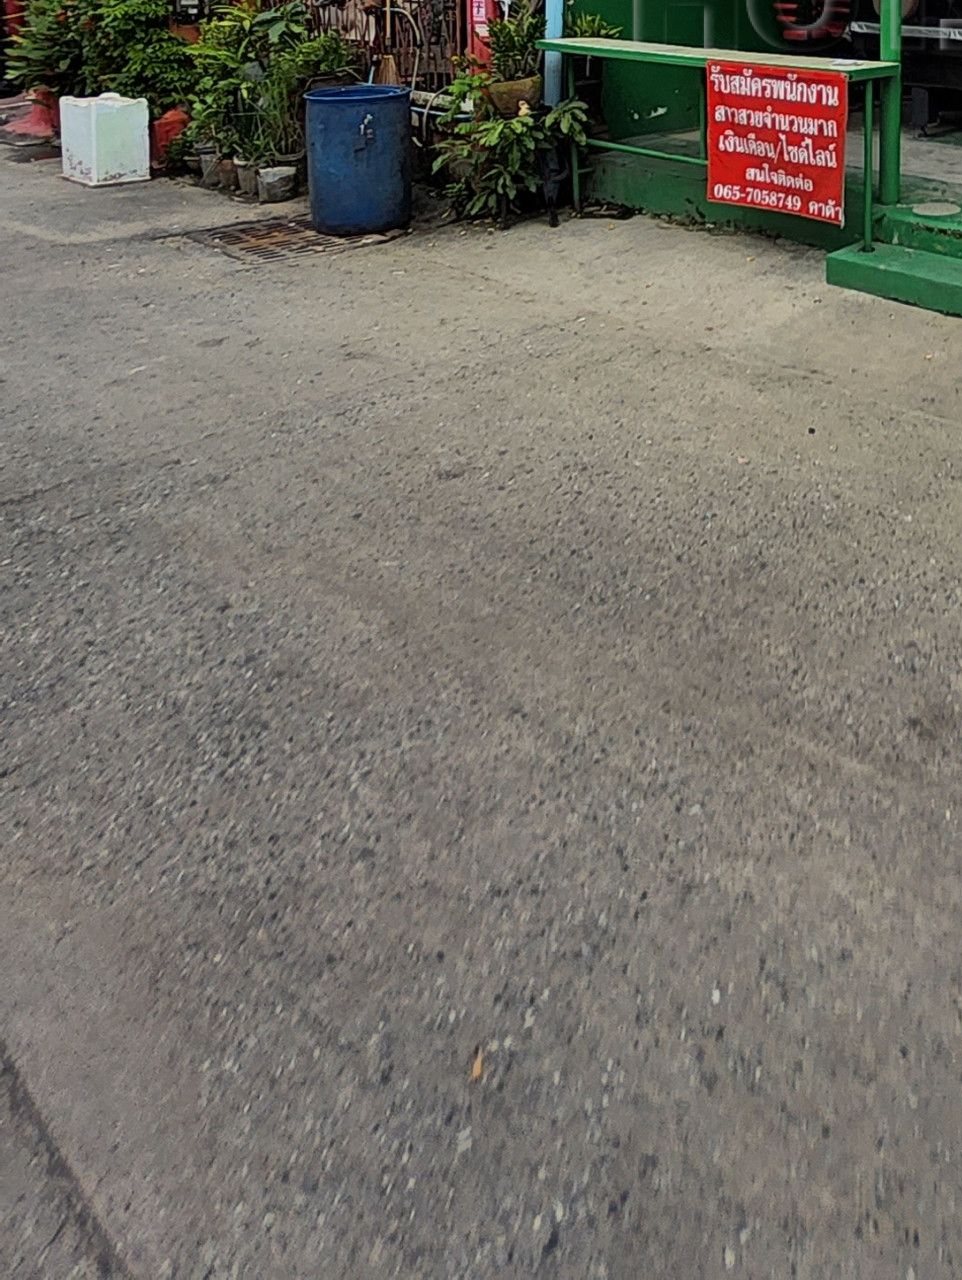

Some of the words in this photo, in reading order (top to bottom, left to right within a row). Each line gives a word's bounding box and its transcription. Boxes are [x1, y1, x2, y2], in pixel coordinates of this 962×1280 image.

[710, 65, 839, 106] รับสมัครพนักงาน
[715, 105, 837, 137] สาวสวยจำนวนมาก
[745, 163, 813, 192] สนใจติดต่อ
[713, 183, 802, 211] 065-7058749
